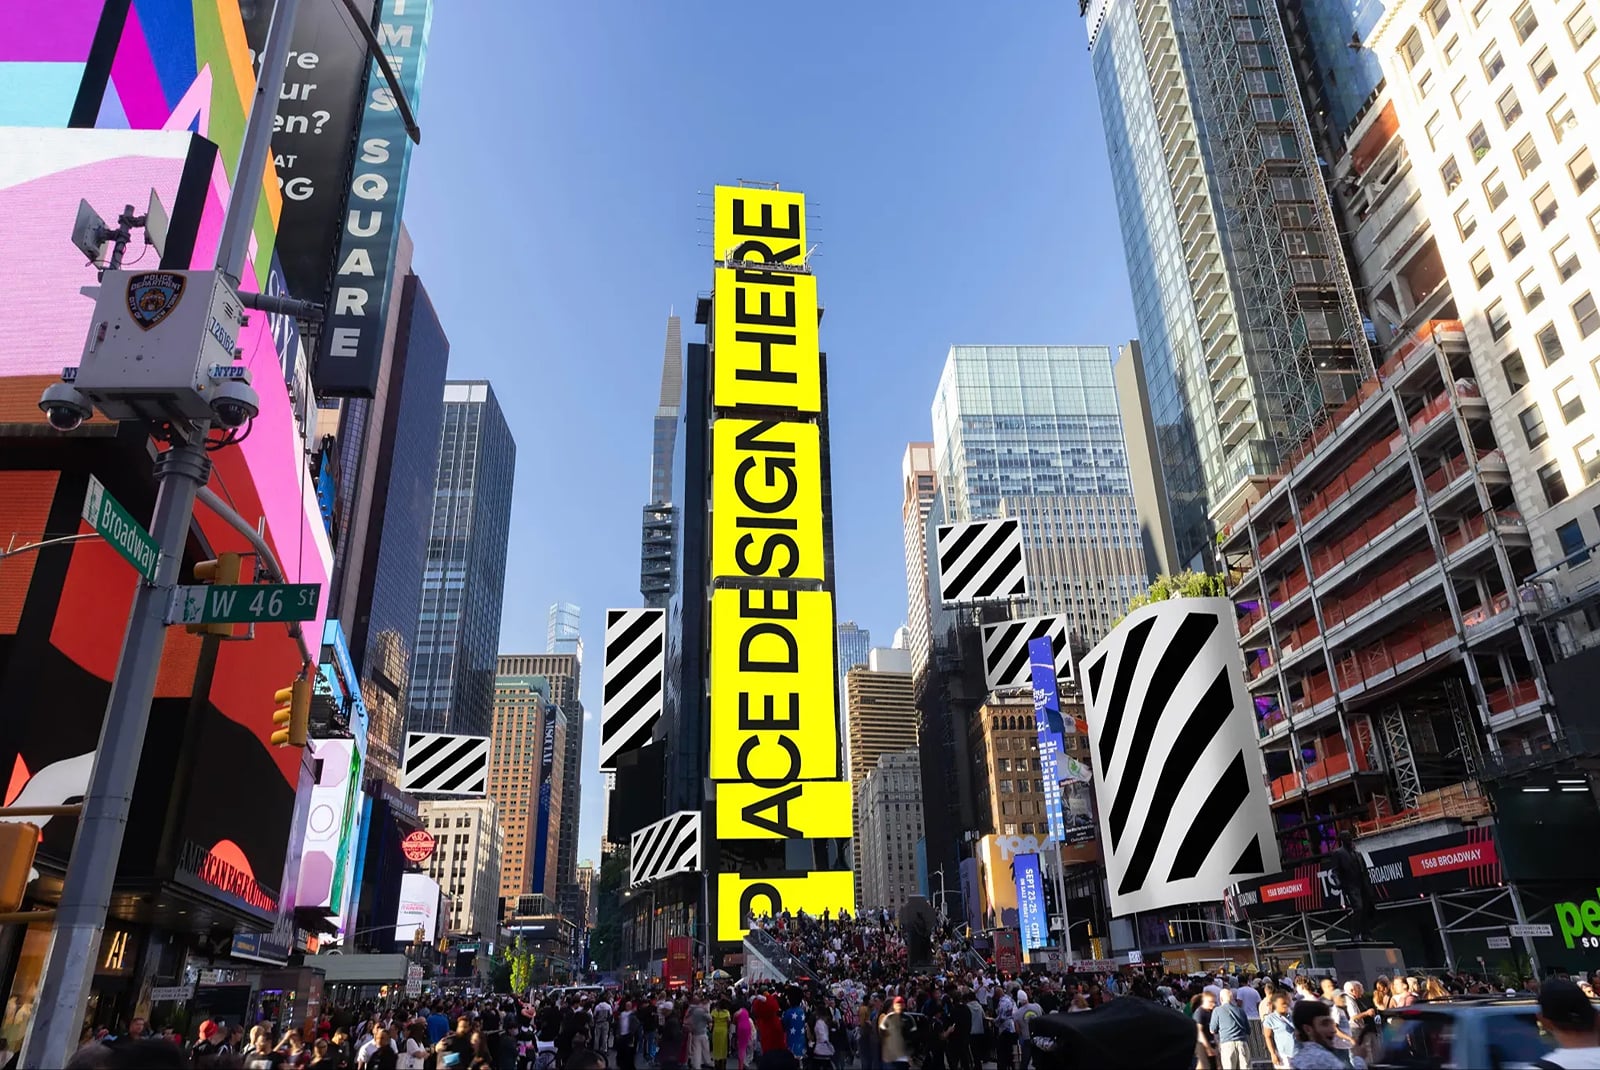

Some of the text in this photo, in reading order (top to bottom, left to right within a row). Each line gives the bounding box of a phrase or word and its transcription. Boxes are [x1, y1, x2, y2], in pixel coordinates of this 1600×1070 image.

[330, 138, 391, 358] SQUARE
[131, 279, 182, 291] DEPARTMENT
[143, 274, 174, 282] POLICE
[732, 198, 802, 385] HERE
[213, 366, 244, 377] NYPD
[101, 499, 158, 578] Broadway
[735, 403, 799, 673] DESIGN
[211, 588, 316, 618] W 46 St
[178, 838, 229, 892] AMERICAN
[1421, 849, 1482, 870] 1568 BROADWAY
[1025, 868, 1035, 889] SEPT
[1267, 883, 1303, 897] 1568 BROADWAY
[1027, 890, 1038, 913] 23-25
[1554, 887, 1600, 949] pe
[1582, 936, 1600, 948] SO
